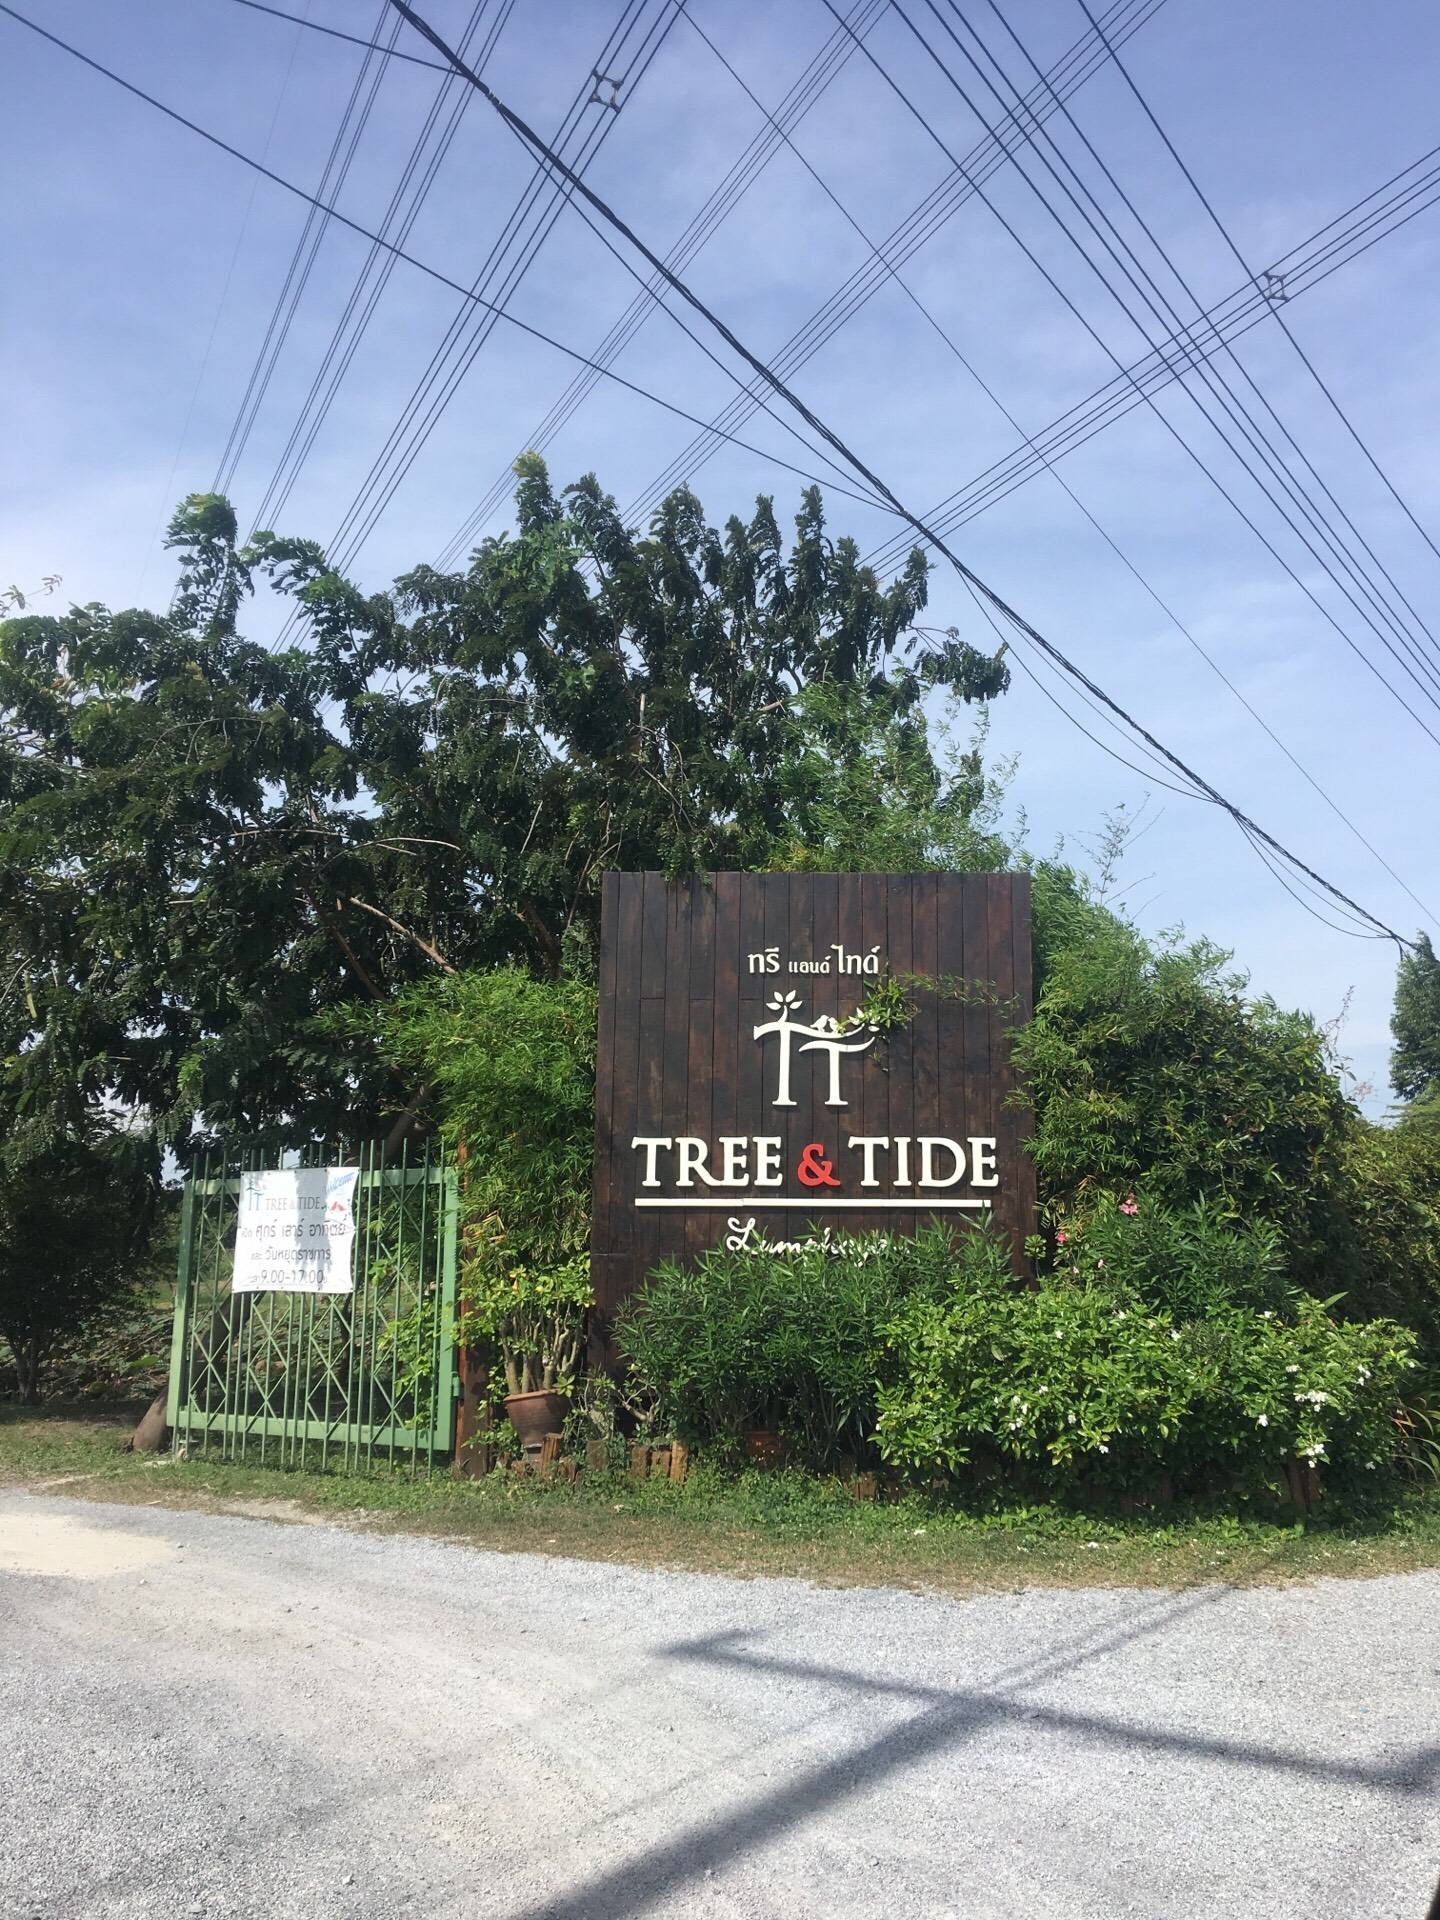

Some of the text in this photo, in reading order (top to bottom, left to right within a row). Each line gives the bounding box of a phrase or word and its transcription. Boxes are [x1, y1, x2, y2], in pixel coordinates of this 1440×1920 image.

[747, 946, 781, 974] ทรี
[830, 943, 881, 974] ไทด์
[631, 1136, 1000, 1187] TREE & TIDE
[266, 1197, 288, 1210] TREE
[298, 1196, 321, 1210] TIDE
